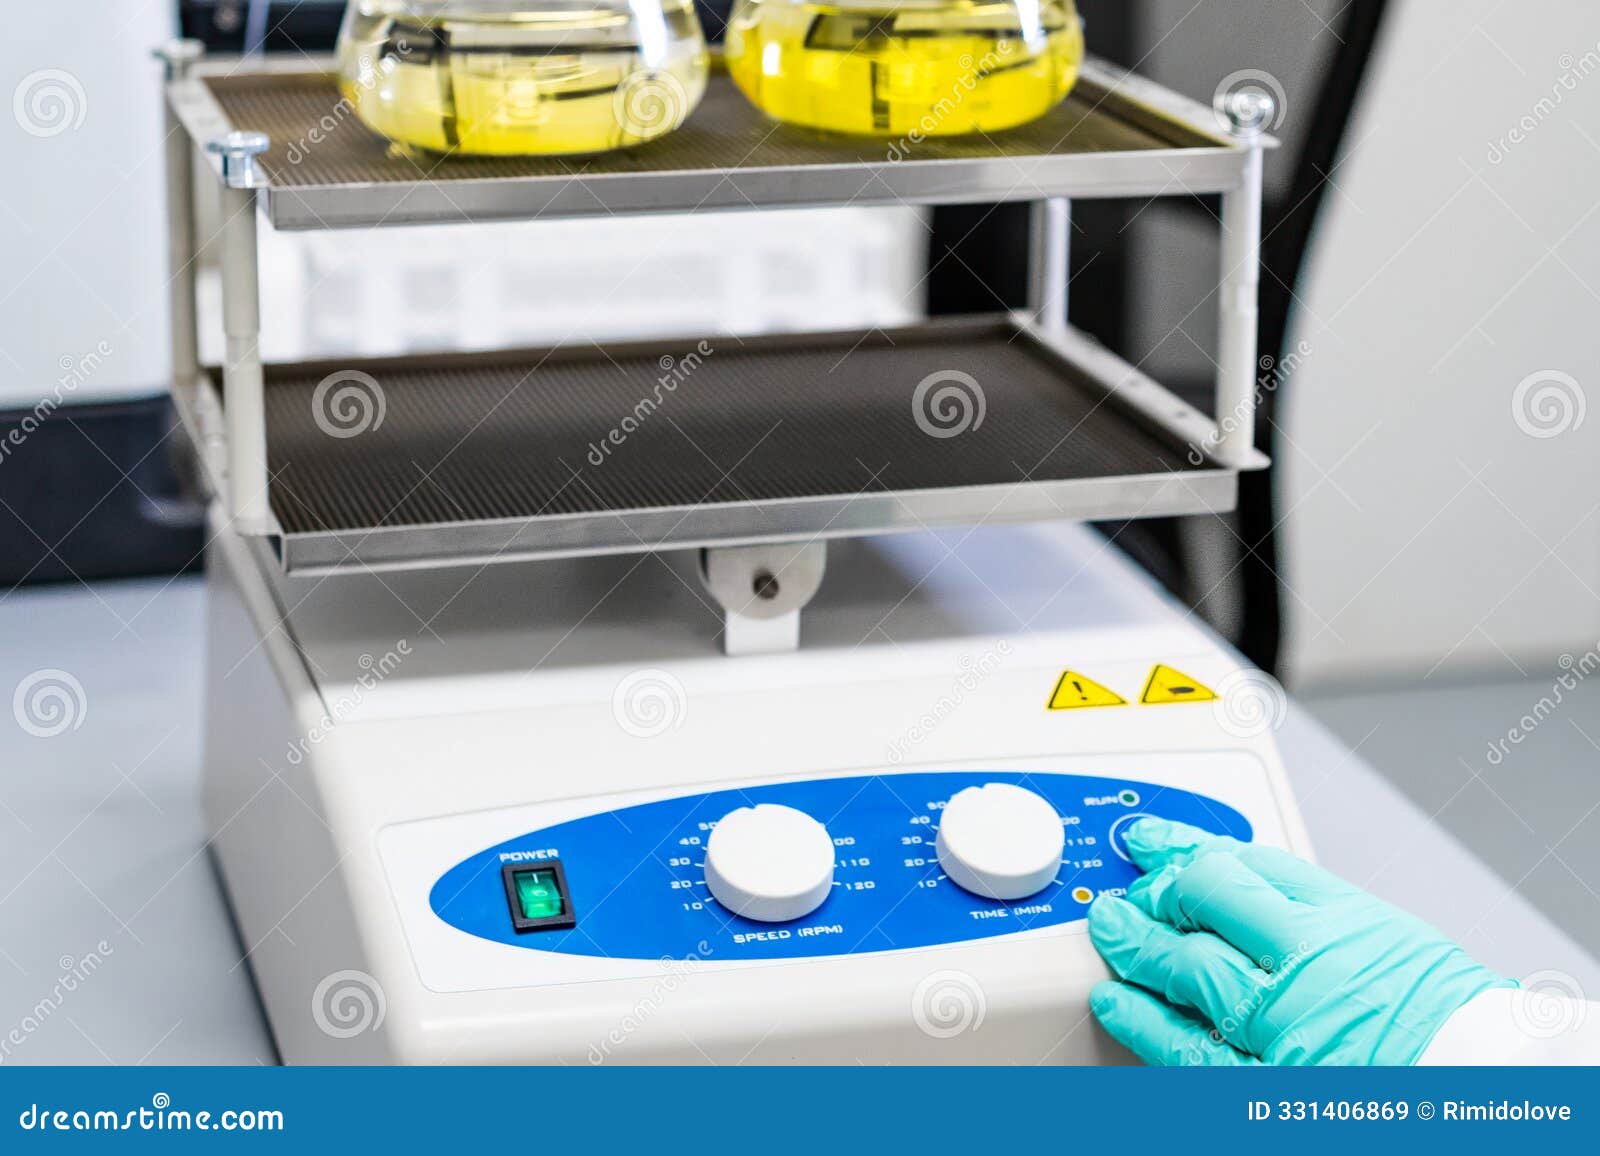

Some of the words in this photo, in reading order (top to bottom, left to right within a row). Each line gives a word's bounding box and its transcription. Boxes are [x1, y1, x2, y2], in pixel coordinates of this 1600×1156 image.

[909, 816, 930, 824] 40
[679, 836, 701, 845] 40
[833, 837, 855, 847] 00
[901, 836, 922, 845] 30
[1066, 837, 1096, 846] 110
[499, 848, 559, 862] POWER
[669, 857, 691, 867] 30
[840, 858, 870, 867] 110
[904, 858, 925, 867] 20
[1074, 859, 1103, 868] 120
[671, 880, 692, 889] 20
[845, 880, 875, 891] 120
[917, 880, 937, 888] 10
[683, 902, 703, 911] 10
[970, 909, 1009, 920] TIME
[1013, 904, 1053, 916] (MIN)
[733, 930, 791, 944] SPEED
[797, 924, 844, 938] (RPM)
